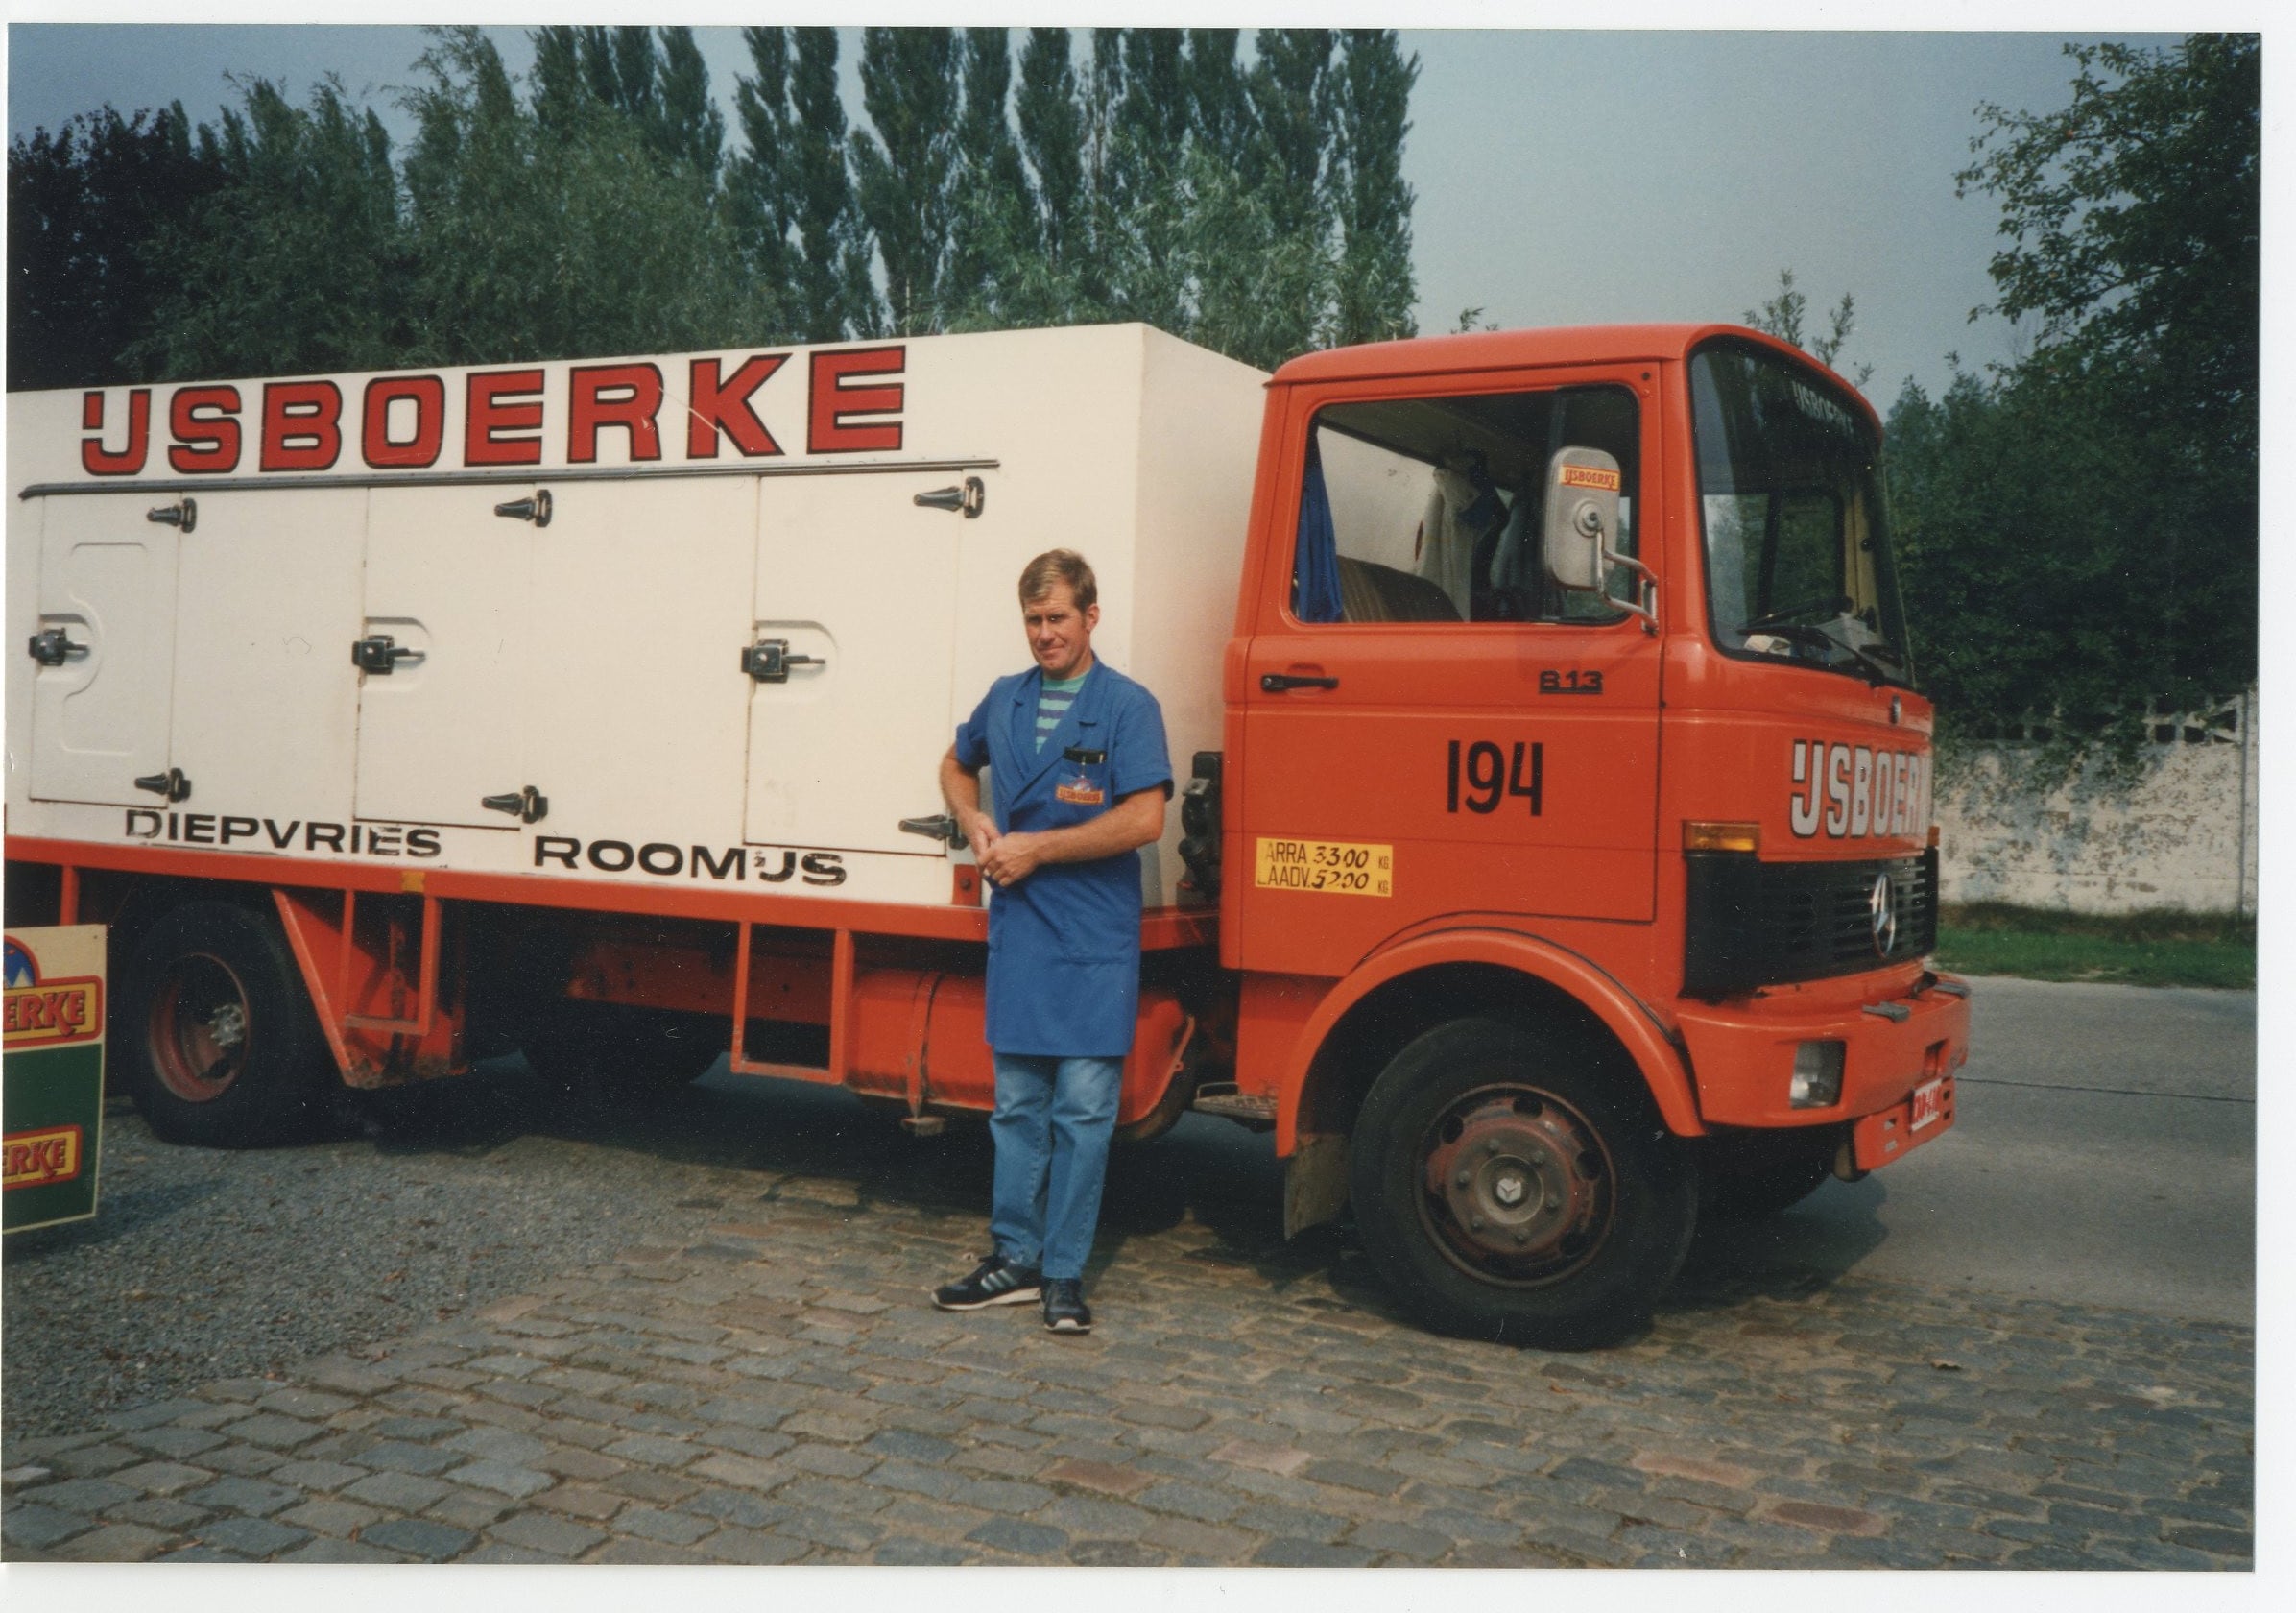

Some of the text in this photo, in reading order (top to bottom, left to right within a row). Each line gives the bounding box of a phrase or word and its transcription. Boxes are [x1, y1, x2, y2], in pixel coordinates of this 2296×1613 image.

[82, 345, 906, 476] IJSBOERKE
[1792, 379, 1854, 435] IJSBOE
[1447, 739, 1543, 817] 194
[125, 809, 442, 857] DIEPVRIES
[1266, 842, 1307, 863] ARRA
[1313, 846, 1369, 868] 3300
